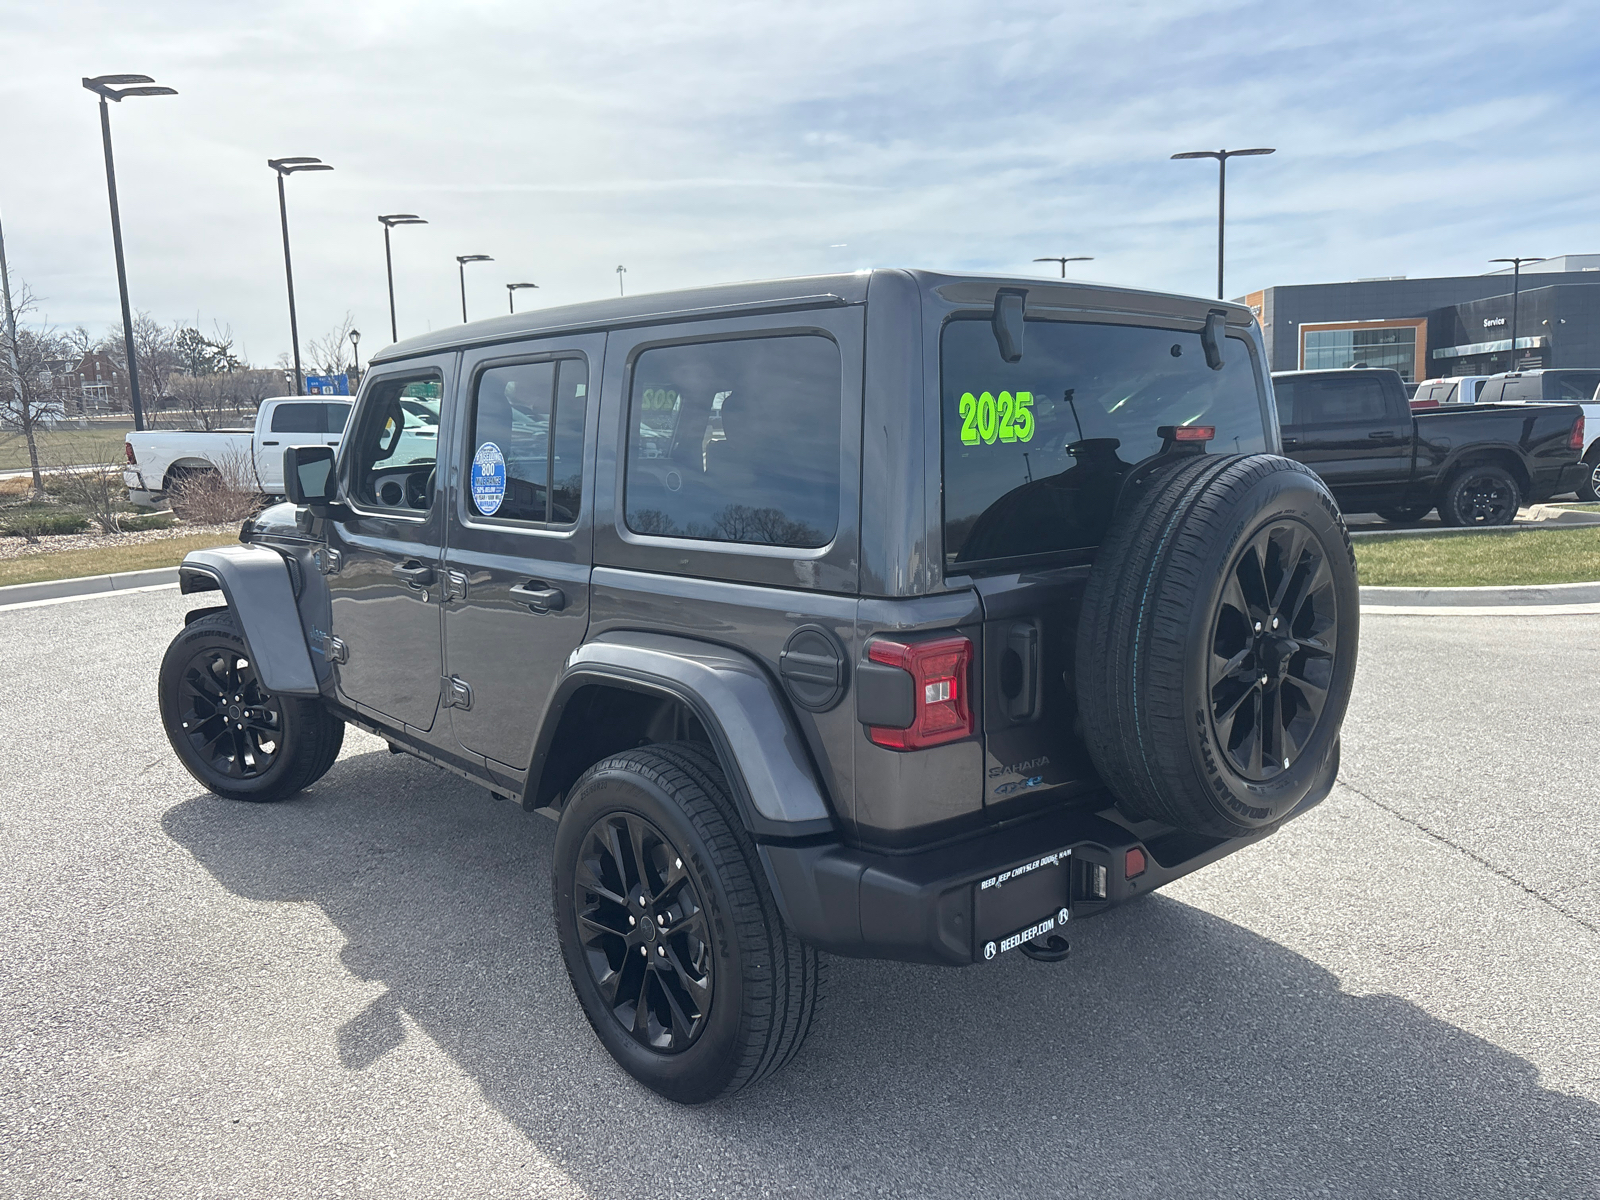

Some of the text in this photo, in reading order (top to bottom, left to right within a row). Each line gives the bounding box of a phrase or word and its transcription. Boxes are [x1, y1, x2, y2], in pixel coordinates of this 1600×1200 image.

[1483, 316, 1505, 328] Service
[958, 390, 1035, 446] 2025
[475, 476, 501, 486] MILE RANGE
[481, 463, 495, 476] 800
[988, 755, 1050, 779] SAHARA
[981, 848, 1072, 890] REED JEEP CHRYSLER DODGE RAM
[690, 852, 730, 959] NEXEN
[1000, 917, 1054, 953] REEDJEEP.COM
